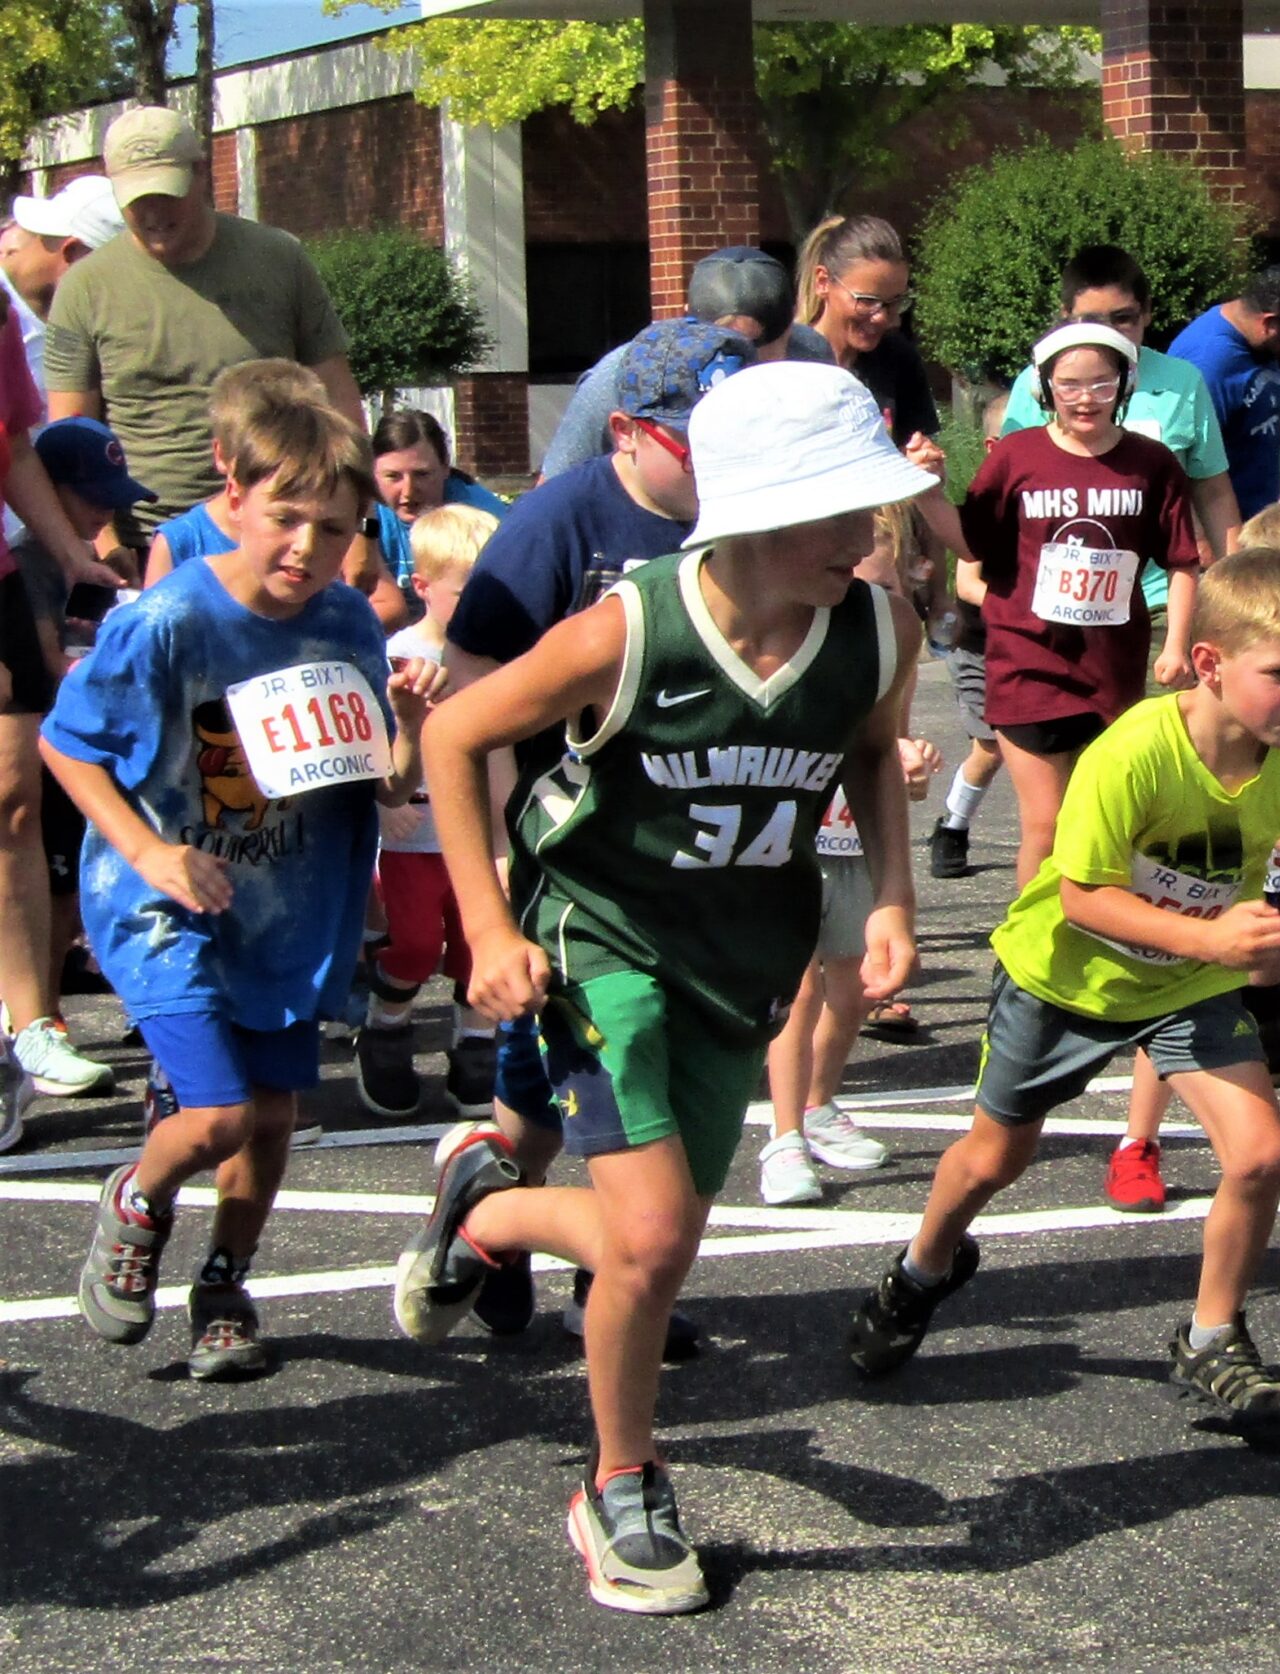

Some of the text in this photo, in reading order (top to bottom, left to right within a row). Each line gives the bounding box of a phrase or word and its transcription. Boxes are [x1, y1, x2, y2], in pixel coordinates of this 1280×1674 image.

[1022, 488, 1079, 519] MHS
[1090, 552, 1112, 565] BIX
[1058, 568, 1119, 603] B370
[1052, 605, 1115, 621] ARCONIC
[261, 667, 345, 699] JR. BIX 7
[261, 691, 373, 753] E1168
[290, 754, 375, 786] ARCONIC
[671, 800, 797, 869] 34
[816, 834, 861, 851] RCON
[1150, 868, 1177, 892] JR.
